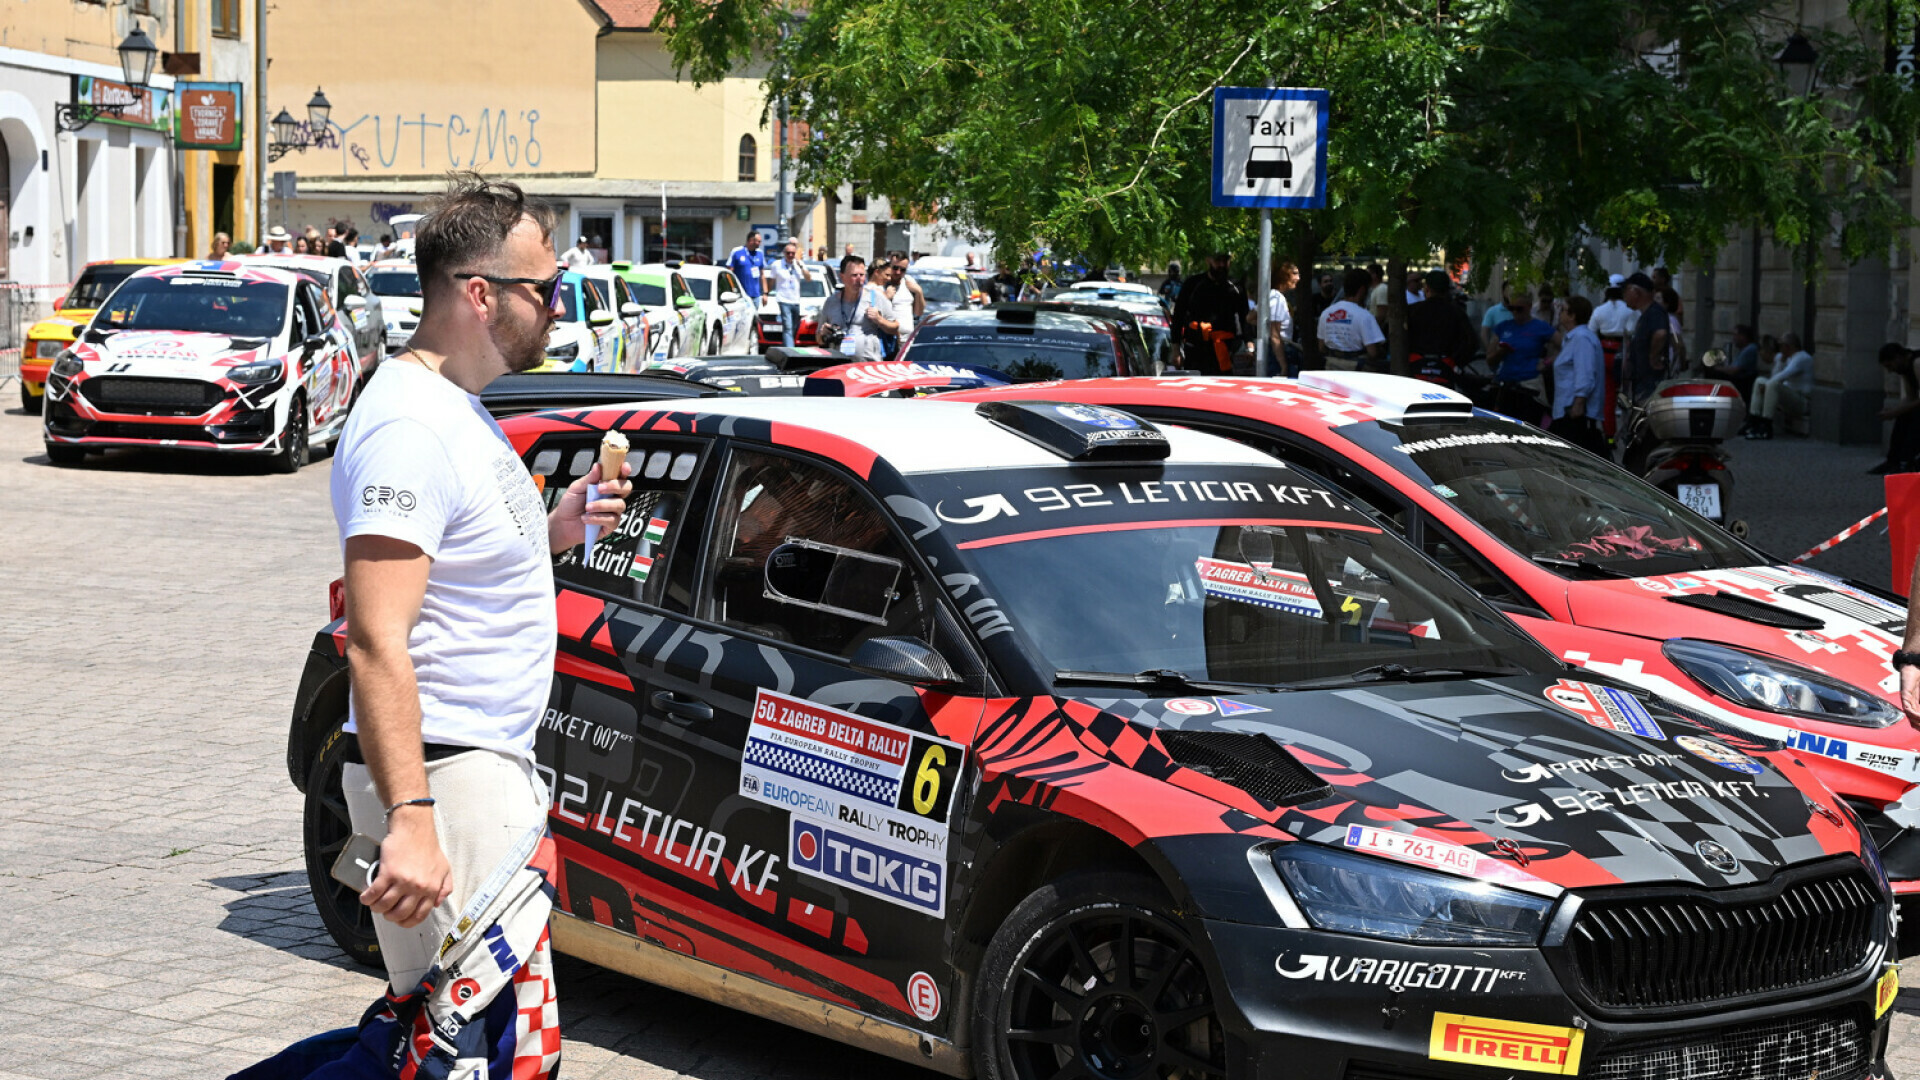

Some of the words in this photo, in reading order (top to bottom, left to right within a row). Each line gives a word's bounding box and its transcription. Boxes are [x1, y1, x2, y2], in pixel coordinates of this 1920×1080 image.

[1246, 115, 1295, 136] Taxi
[1024, 483, 1113, 512] 92
[1118, 481, 1263, 504] LETICIA
[1267, 483, 1350, 511] KFT.
[614, 508, 645, 537] zló
[1206, 566, 1252, 584] ZAGREB
[541, 708, 594, 741] AKET
[593, 725, 621, 751] 007
[758, 699, 777, 723] 50.
[779, 707, 826, 735] ZAGREB
[828, 722, 865, 746] DELTA
[867, 732, 907, 759] RALLY
[770, 732, 783, 742] FIA
[784, 736, 823, 752] EUROPEAN
[824, 747, 849, 761] RALLY
[850, 755, 881, 771] TROPHY
[1549, 755, 1636, 777] PAKET
[912, 744, 947, 815] 6
[763, 781, 834, 817] EUROPEAN
[838, 805, 884, 832] RALLY
[887, 820, 946, 851] TROPHY
[1553, 790, 1614, 816] 92
[1614, 780, 1711, 805] LETICIA
[1709, 781, 1769, 798] KFT.
[596, 791, 727, 877] LETICIA
[827, 839, 937, 903] TOKIĆ
[1403, 839, 1471, 868] 761-AG
[1329, 956, 1500, 992] VARIGOTTI
[1500, 969, 1527, 981] KFT.
[917, 983, 930, 1010] E
[1443, 1023, 1571, 1066] PIRELLI
